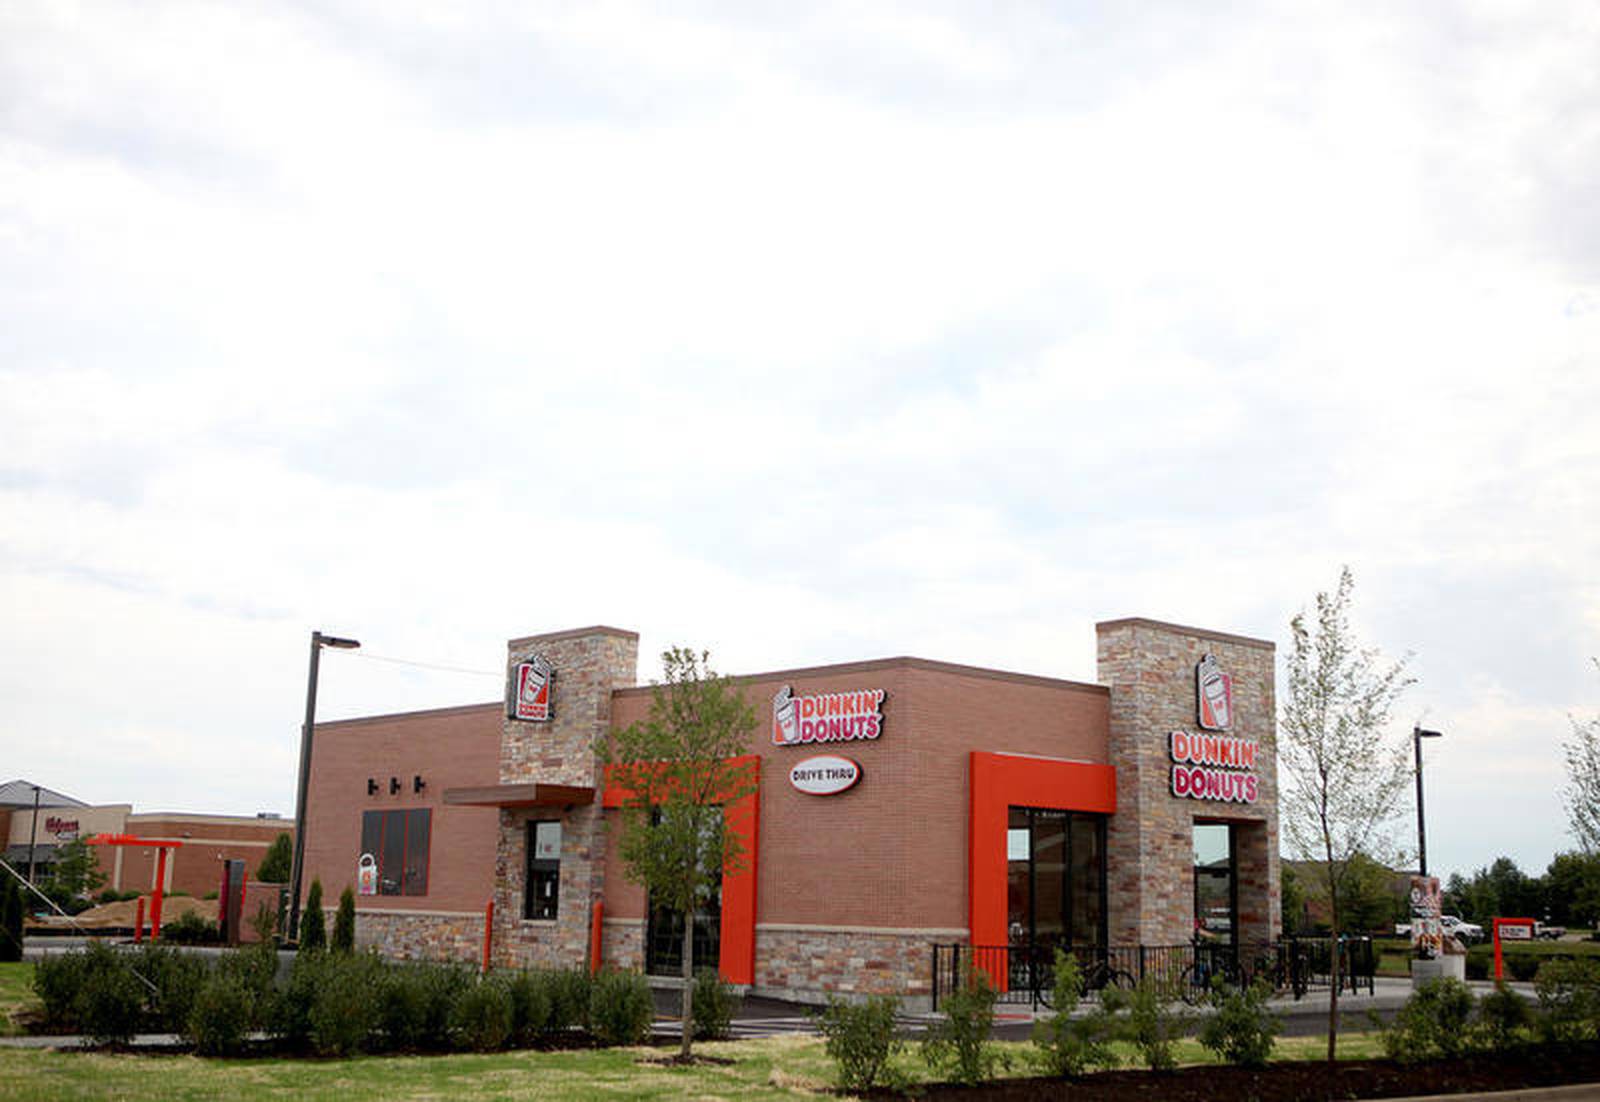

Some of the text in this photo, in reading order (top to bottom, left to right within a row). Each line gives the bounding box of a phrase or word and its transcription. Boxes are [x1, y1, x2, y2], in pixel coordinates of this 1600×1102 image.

[801, 690, 884, 718] DUNKIN'
[801, 715, 880, 741] DONUTS
[1172, 732, 1259, 767] DUNKIN'
[793, 767, 855, 781] DRIVE THRU
[1173, 767, 1258, 802] DONUTS
